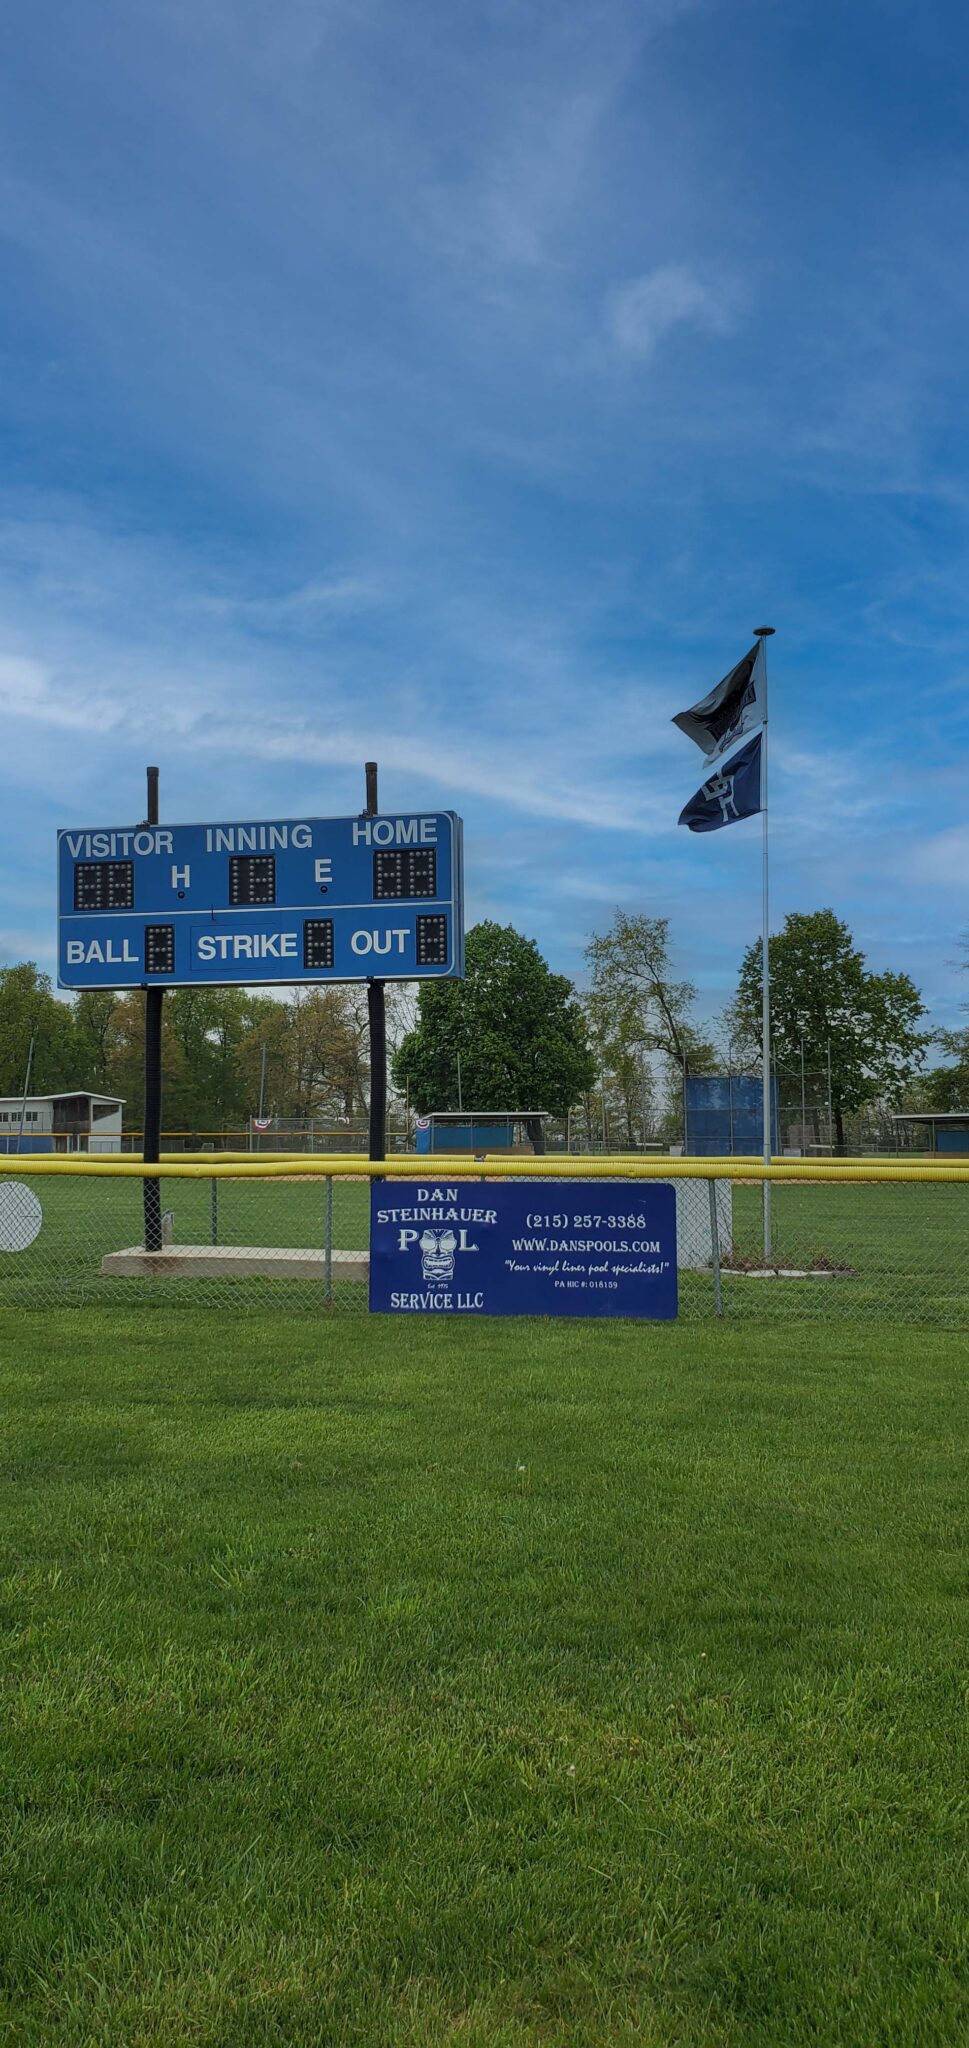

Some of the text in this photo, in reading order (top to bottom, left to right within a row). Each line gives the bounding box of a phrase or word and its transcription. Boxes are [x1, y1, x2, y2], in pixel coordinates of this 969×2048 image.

[66, 831, 173, 858] VISITOR
[206, 824, 313, 853] INNING
[352, 819, 438, 846] HOME
[172, 864, 190, 889] H
[315, 858, 333, 883] E
[66, 938, 139, 964] BALL
[197, 933, 298, 961] STRIKE
[350, 929, 411, 956] OUT
[417, 1189, 458, 1202] DAN
[377, 1208, 498, 1224] STEINHAUER
[526, 1213, 646, 1229] (215) 257-3388
[512, 1238, 661, 1253] WWW.DANSPOOLS.COM
[532, 1260, 560, 1276] vinyl
[562, 1261, 586, 1272] liner
[588, 1261, 609, 1276] pool
[554, 1280, 566, 1288] PA
[390, 1292, 484, 1310] SERVICE LLC
